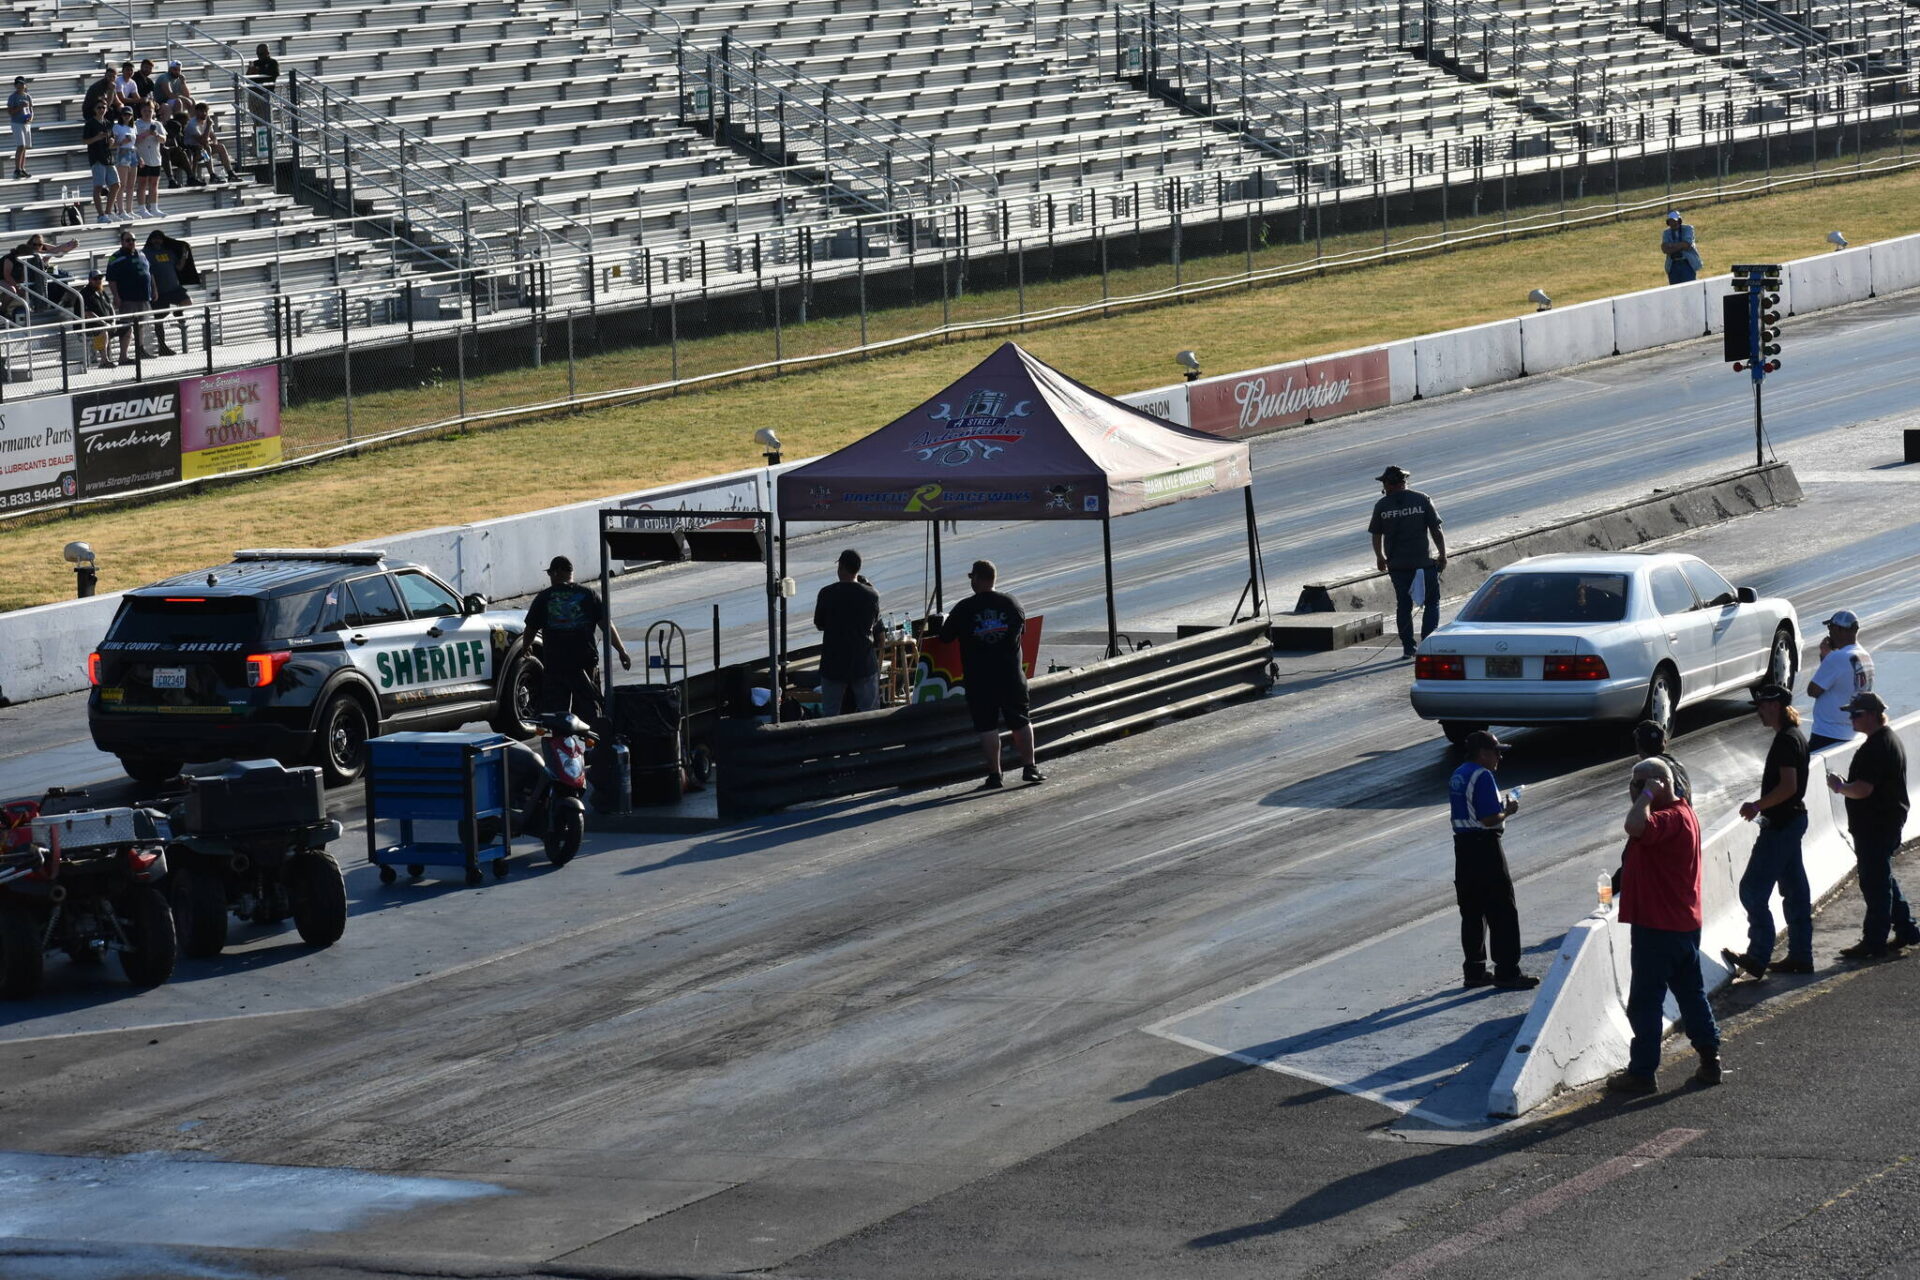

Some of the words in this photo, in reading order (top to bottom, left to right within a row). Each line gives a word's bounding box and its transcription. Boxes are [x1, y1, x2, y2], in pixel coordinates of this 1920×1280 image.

[202, 383, 261, 412] TRUCK
[1136, 400, 1169, 417] SSION
[1234, 372, 1349, 430] Budweiser
[80, 394, 174, 426] STRONG
[206, 418, 260, 445] TOWN
[967, 418, 997, 427] STREET
[46, 427, 73, 447] Parts
[84, 430, 172, 453] Trucking
[5, 459, 47, 474] LUBRICANTS
[48, 454, 74, 467] DEALER
[85, 467, 175, 491] www.StrongTrucking.net
[1381, 505, 1425, 519] OFFICIAL
[125, 641, 161, 651] COUNTY
[178, 642, 243, 651] SHERIFF
[376, 640, 485, 688] SHERIFF
